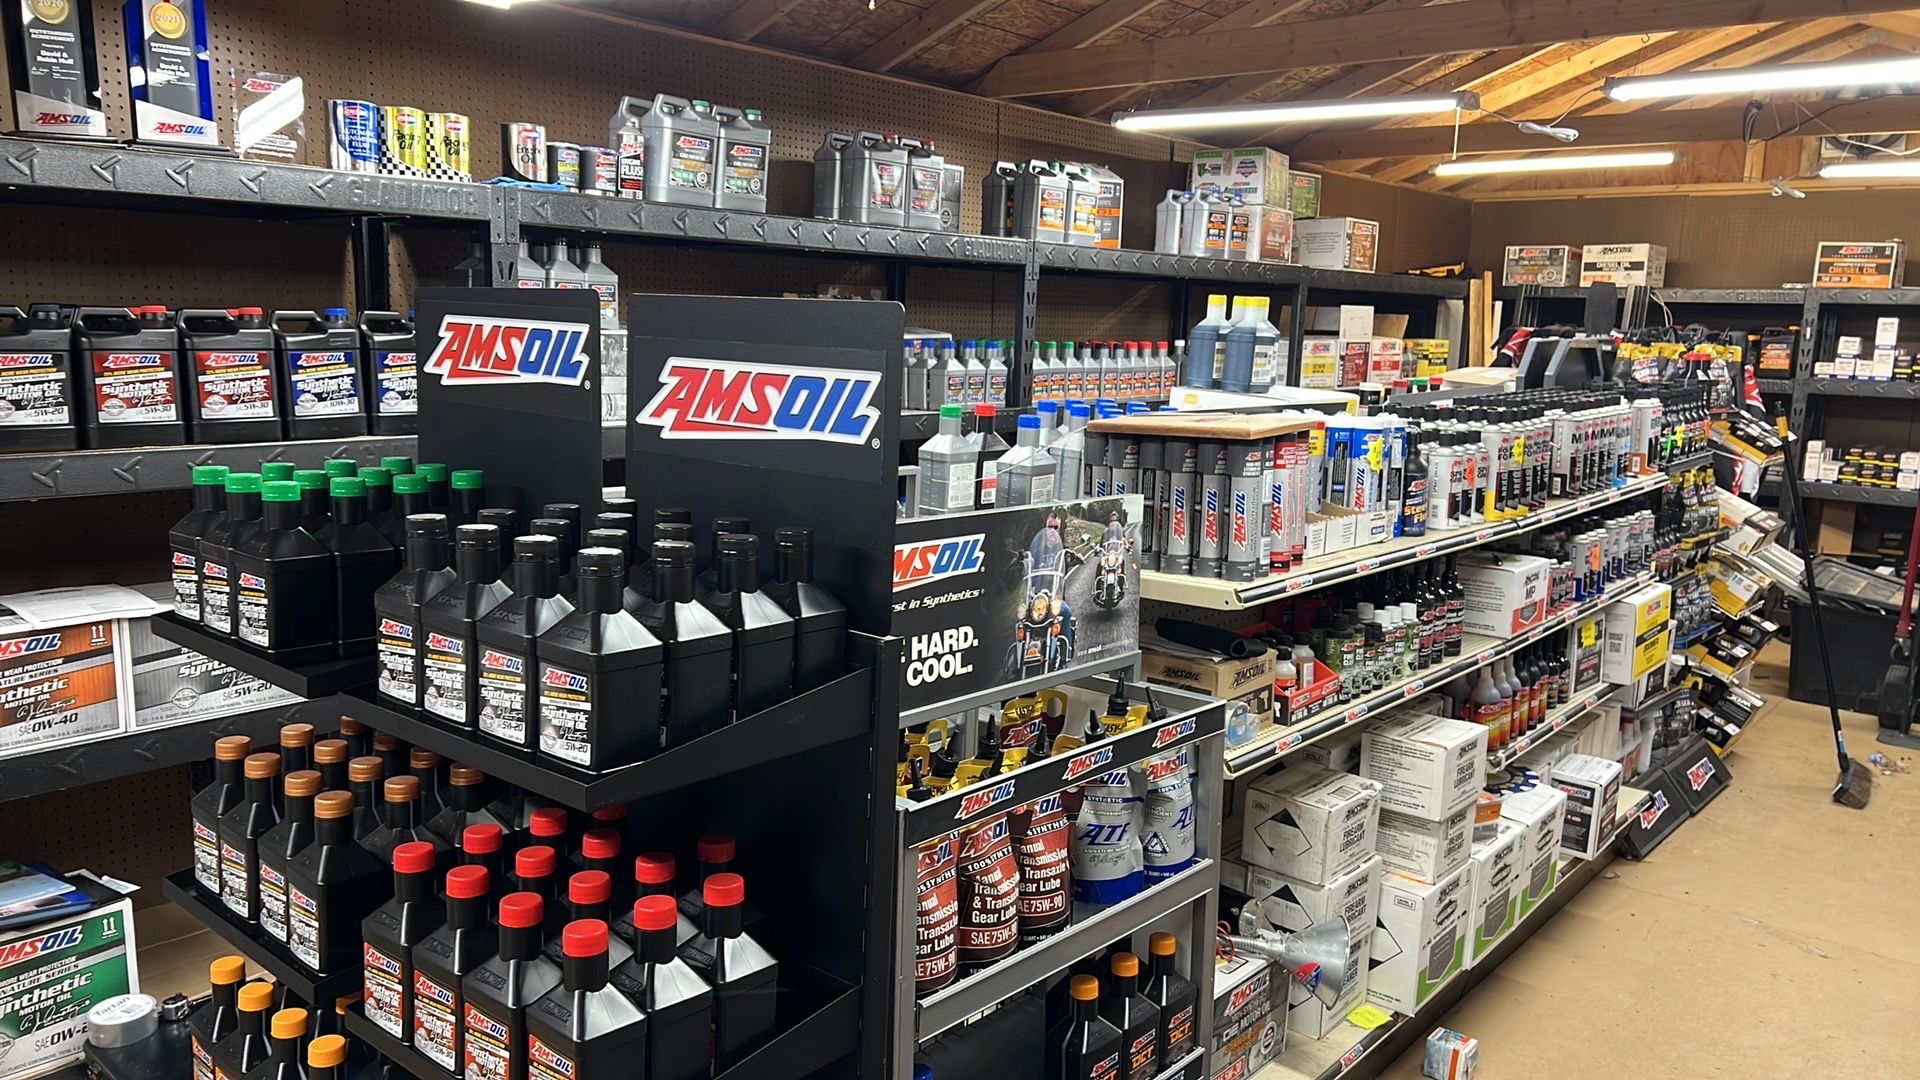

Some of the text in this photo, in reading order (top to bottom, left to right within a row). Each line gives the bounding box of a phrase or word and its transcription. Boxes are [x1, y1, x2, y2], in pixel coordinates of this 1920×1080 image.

[33, 112, 92, 126] AMSOIL
[153, 122, 205, 135] AMSOIL
[678, 136, 710, 149] AMSOIL
[1599, 246, 1633, 256] AMSOIL
[1828, 266, 1879, 275] DIESEL OIL
[205, 353, 259, 366] AMSOIL
[297, 353, 345, 366] AMSOIL
[431, 320, 587, 380] AMSOIL
[103, 354, 161, 368] AMSOIL
[0, 381, 62, 397] ynthetic
[6, 389, 61, 401] MOTOR OIL
[101, 380, 170, 397] Synthetic
[204, 378, 267, 393] Synthetic
[297, 376, 353, 393] Synthetic
[645, 365, 875, 437] AMSOIL
[1354, 466, 1366, 512] AMSOIL
[1172, 486, 1187, 545] AMSOIL
[1204, 488, 1218, 548] AMSOIL
[1270, 481, 1284, 539] AMSOIL
[1233, 490, 1248, 552] AMSOIL
[893, 538, 982, 586] MSOIL
[908, 598, 920, 610] in
[921, 588, 980, 608] Synthetics
[379, 619, 413, 640] AMSOIL
[0, 634, 60, 656] MSOIL
[426, 633, 463, 655] AMSOIL
[911, 625, 978, 661] HARD.
[4, 658, 64, 677] WEAR PROTECTION
[481, 650, 523, 673] AMSOIL
[906, 652, 973, 687] COOL.
[28, 668, 58, 680] SERIES
[542, 668, 588, 692] AMSOIL
[1160, 666, 1202, 681] AMSOIL
[1230, 661, 1266, 688] AMSOIL
[4, 694, 51, 709] MOTOR OIL
[32, 713, 79, 732] 0W-40
[542, 705, 589, 724] Synthetic
[1154, 717, 1196, 747] AMSOIL
[565, 742, 588, 753] 5W-20
[1064, 746, 1112, 779] AMSOIL
[956, 780, 1015, 819] AMSOIL
[1340, 830, 1366, 853] LUBRICANT
[1343, 821, 1365, 841] FIREARM
[1021, 839, 1044, 854] anual
[1025, 866, 1066, 880] Transaxle
[1020, 878, 1061, 893] ear Lube
[917, 893, 938, 912] anual
[973, 897, 981, 909] &
[1030, 899, 1063, 913] 75W-90
[972, 909, 998, 924] Gear
[0, 929, 81, 967] MSOIL
[916, 934, 954, 955] ear Lube
[971, 932, 990, 945] SAE
[19, 956, 77, 981] WEAR PROTECTION
[45, 964, 80, 979] SERIES
[366, 948, 400, 976] AMSOIL
[926, 954, 956, 975] 75W-90
[416, 976, 453, 1005] AMSOIL
[1225, 968, 1271, 1015] AMSOIL
[19, 991, 73, 1017] MOTOR OIL
[466, 1009, 507, 1041] AMSOIL
[1169, 1022, 1191, 1044] DCT
[1223, 1023, 1239, 1042] OE
[34, 1036, 50, 1052] SAE
[530, 1041, 573, 1076] AMSOIL
[1131, 1045, 1155, 1069] DCT
